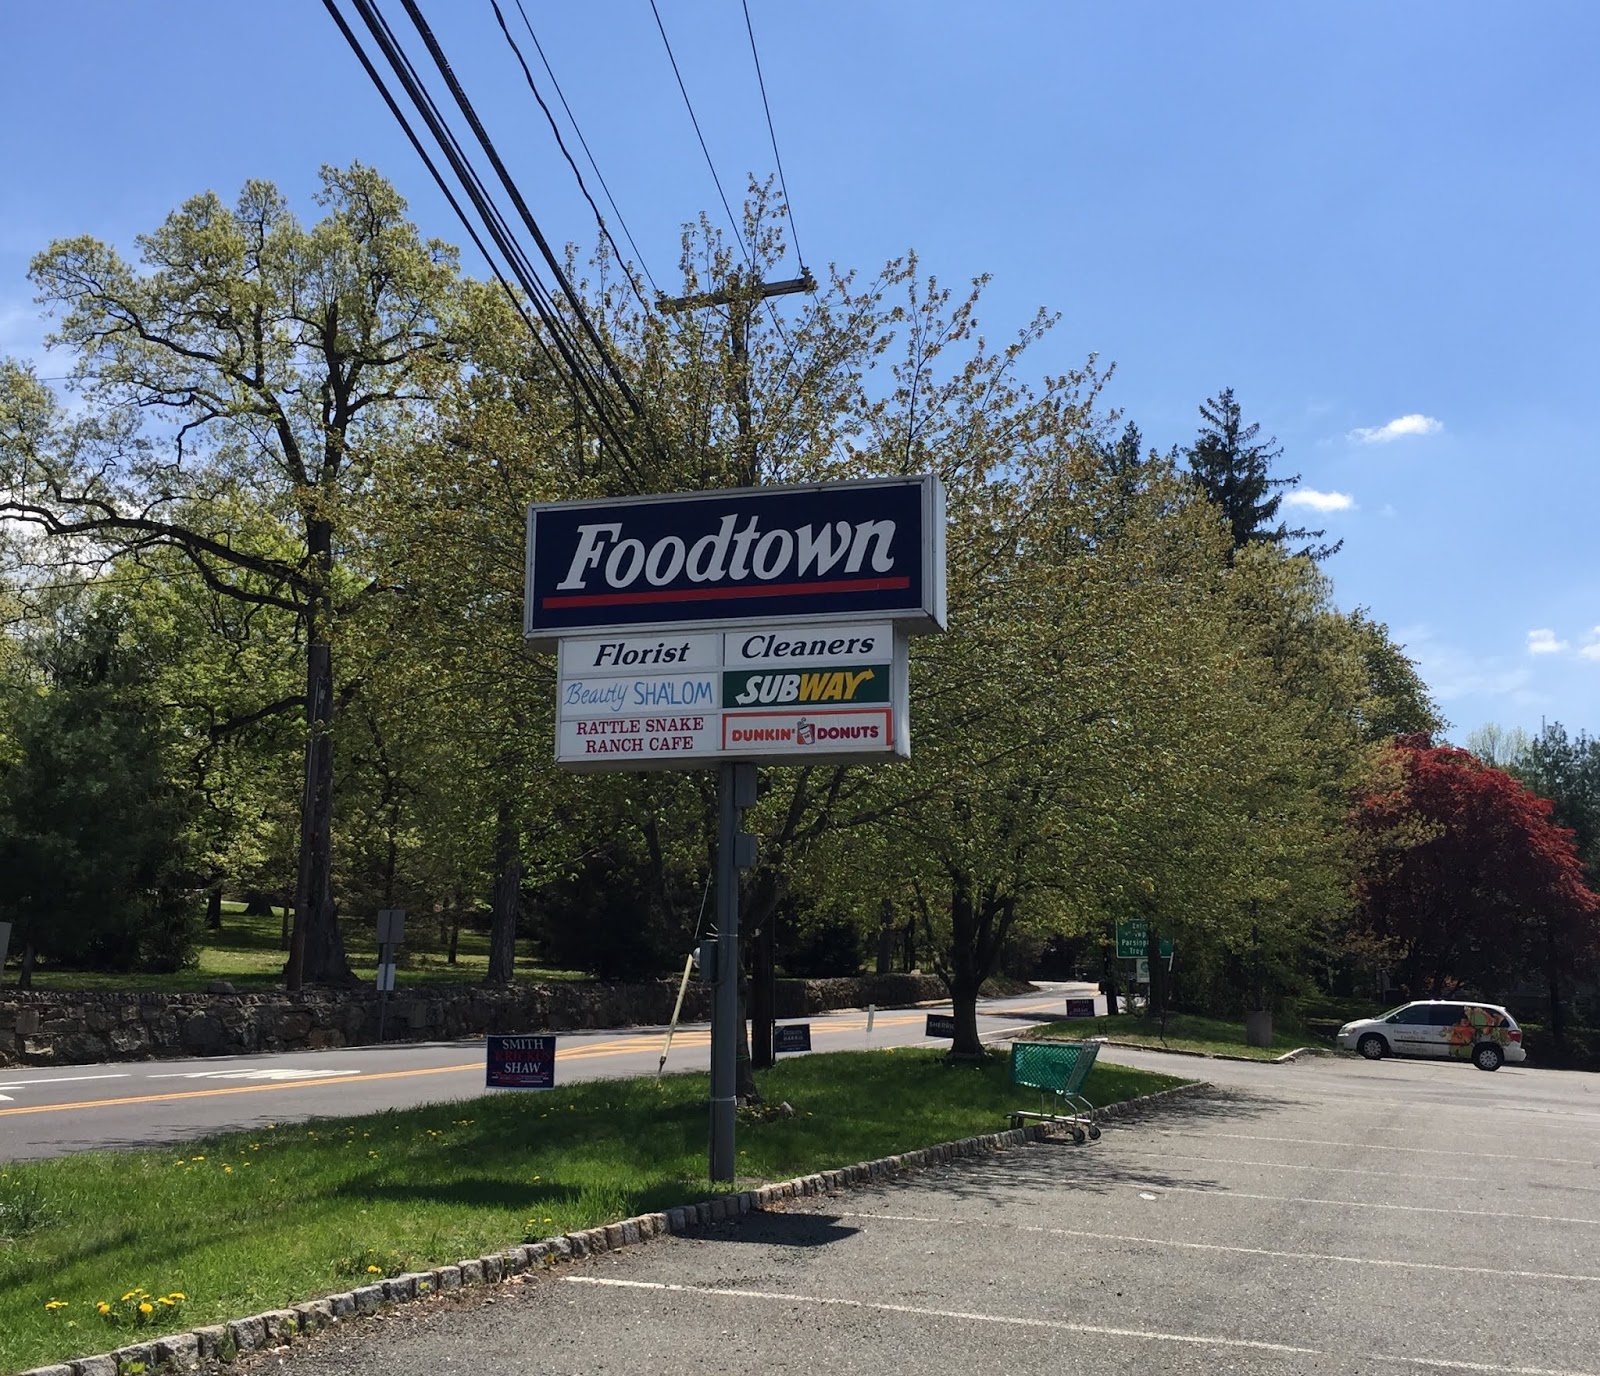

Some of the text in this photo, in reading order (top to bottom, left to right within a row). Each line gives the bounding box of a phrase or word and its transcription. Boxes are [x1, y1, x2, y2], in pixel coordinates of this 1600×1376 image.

[556, 513, 897, 590] Foodtown
[593, 642, 690, 666] Florist
[741, 634, 875, 659] Cleaners
[564, 681, 628, 712] Beauty
[735, 669, 875, 705] SUBWAY
[576, 717, 704, 735] RATTLE SNAKE
[732, 726, 879, 742] DUNKIN' DONUTS
[585, 736, 694, 753] RANCH CAFE
[502, 1039, 544, 1050] SMITH
[504, 1062, 541, 1073] SHAW
